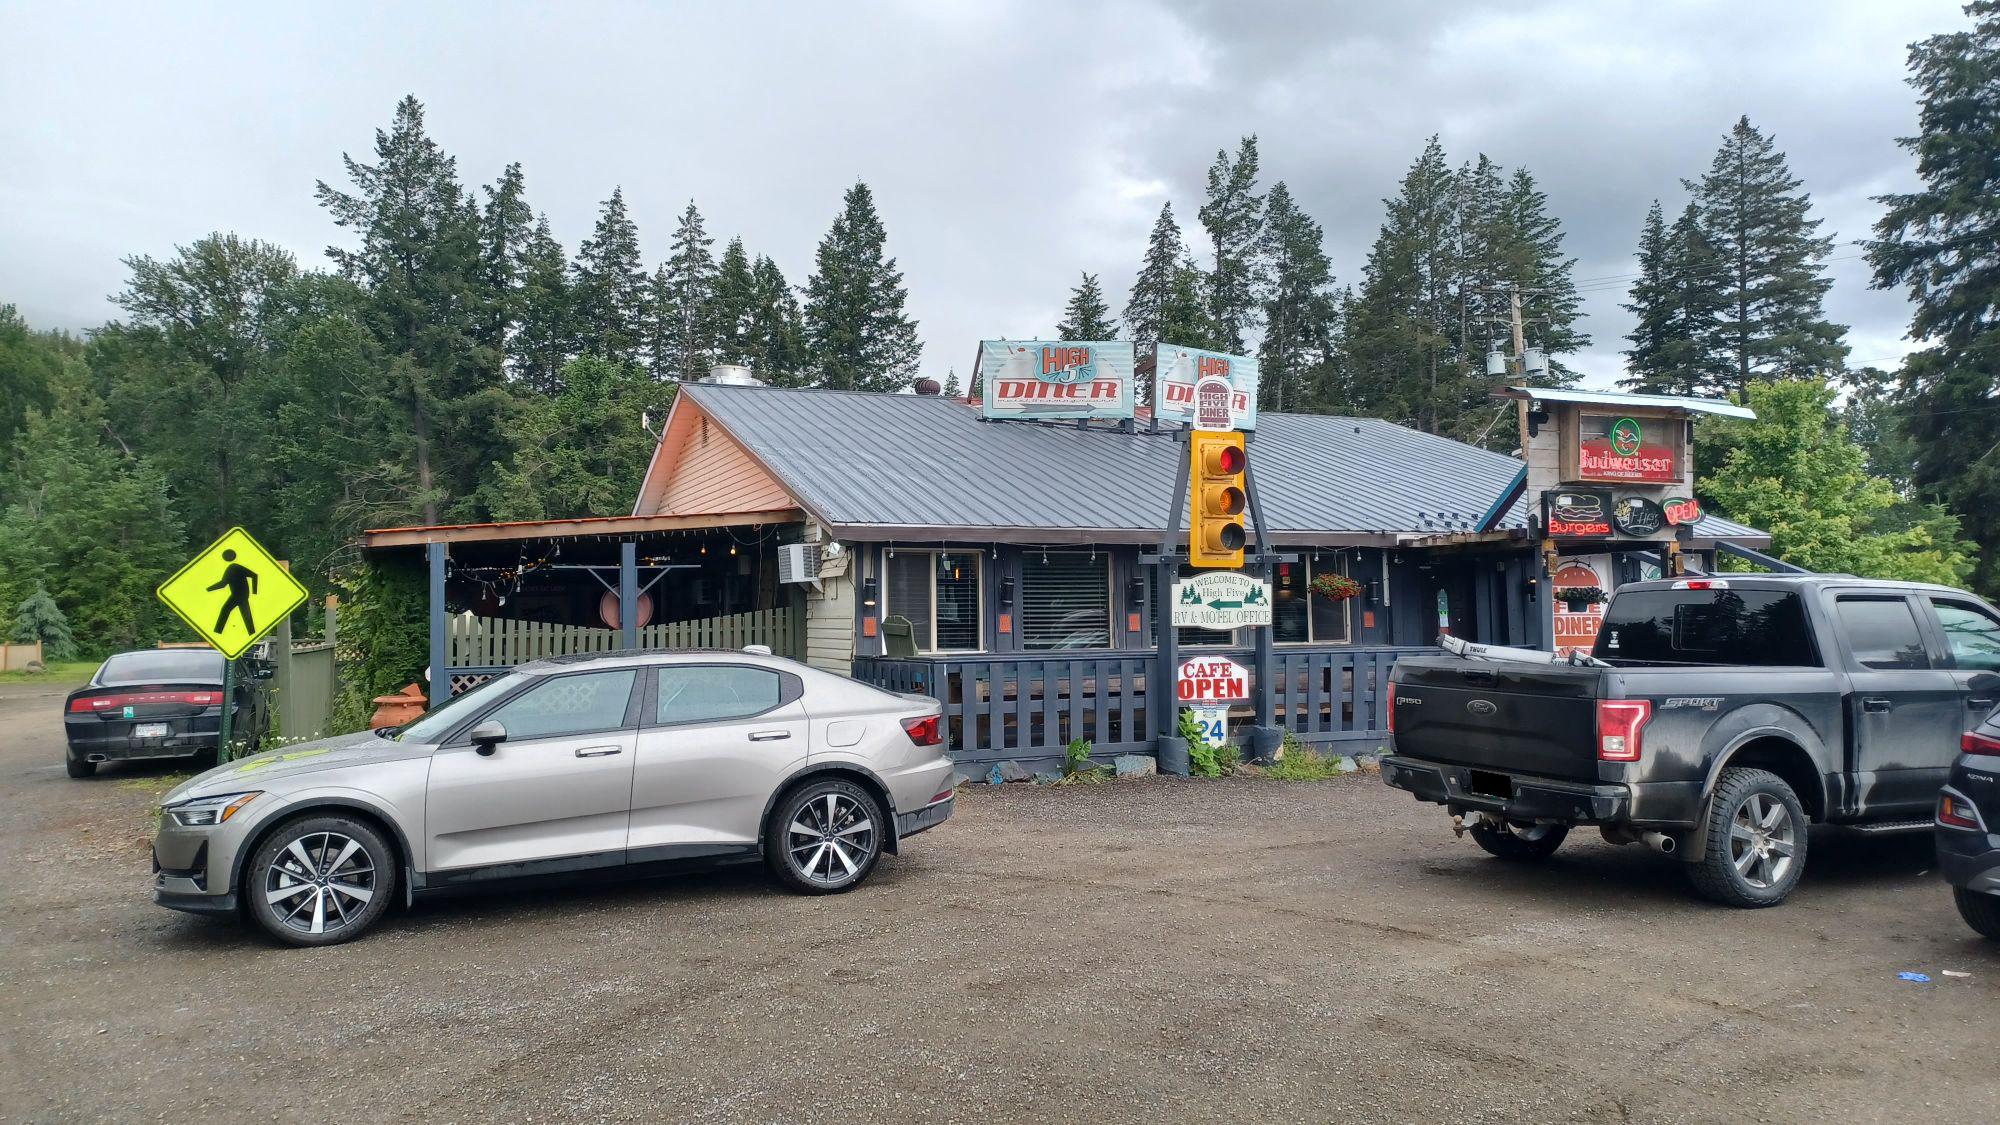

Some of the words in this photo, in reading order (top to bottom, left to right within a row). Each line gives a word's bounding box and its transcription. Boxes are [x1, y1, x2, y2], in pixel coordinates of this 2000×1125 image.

[1043, 347, 1090, 374] HIGH
[1198, 356, 1230, 379] HIGH
[1059, 363, 1077, 383] 5
[998, 381, 1118, 399] DINER
[1166, 385, 1247, 410] DIR
[1199, 392, 1229, 400] HIGH
[1200, 407, 1229, 418] DINER
[1580, 449, 1672, 473] Budweiser
[1665, 499, 1699, 525] OPEN
[1549, 519, 1609, 535] Burgers
[1195, 575, 1238, 587] WELCOME
[1238, 577, 1250, 586] TO
[1202, 588, 1223, 599] High
[1226, 588, 1245, 597] Five
[1554, 602, 1601, 613] FE
[1174, 611, 1188, 624] RV
[1190, 611, 1198, 623] &
[1201, 611, 1234, 623] MOTEL
[1236, 610, 1270, 623] OFFICE
[1554, 616, 1603, 635] DINER
[1183, 662, 1232, 678] CAFE
[1177, 678, 1243, 699] OPEN
[1660, 698, 1725, 709] SPORT
[1199, 720, 1224, 741] 24
